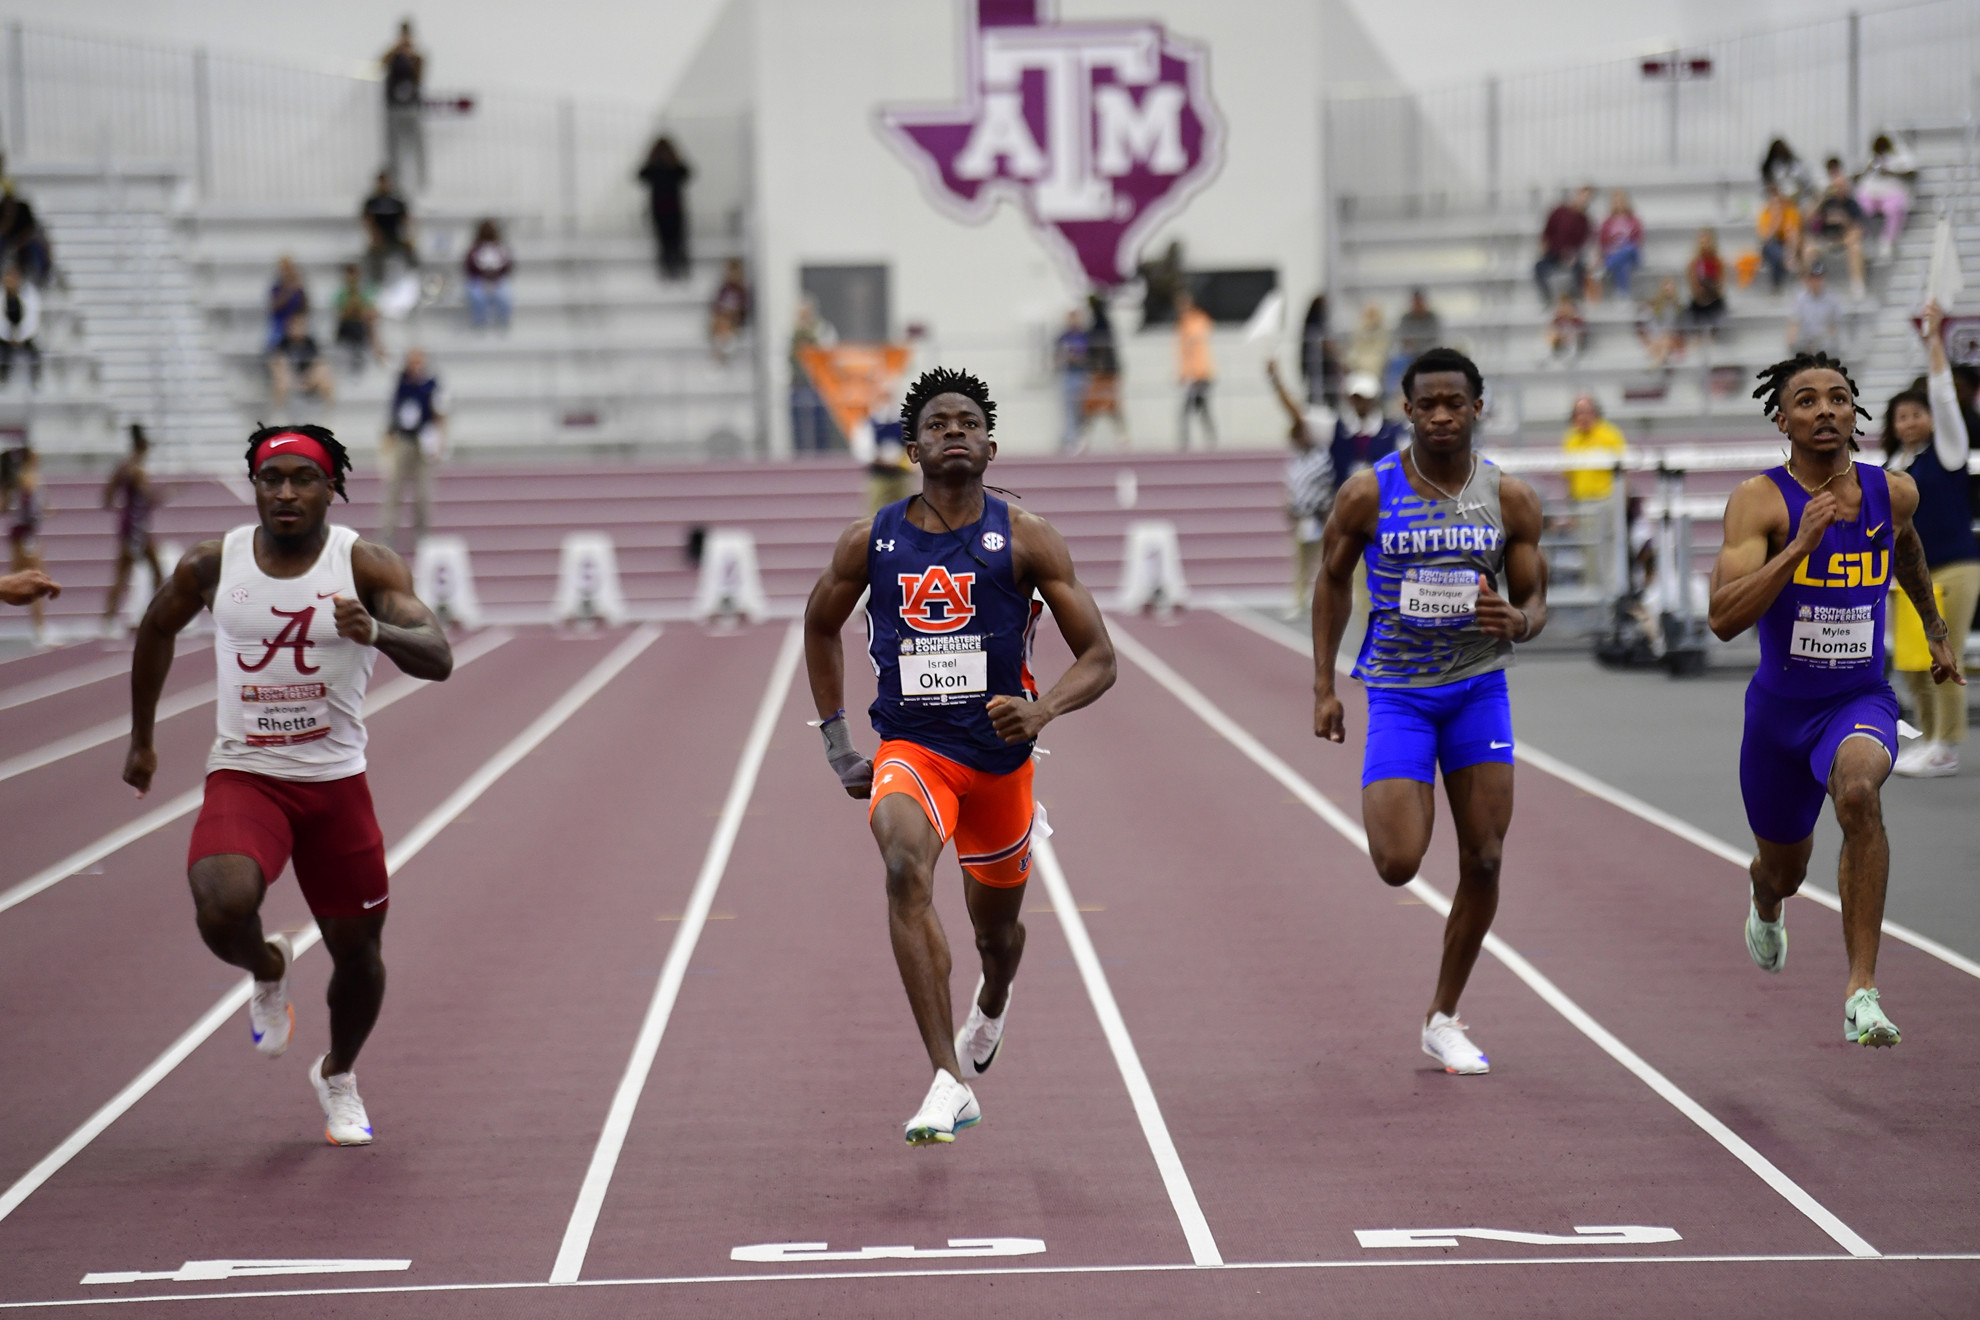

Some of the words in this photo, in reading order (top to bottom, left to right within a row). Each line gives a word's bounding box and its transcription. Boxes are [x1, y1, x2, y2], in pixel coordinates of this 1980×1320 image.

[983, 531, 1005, 551] SEC
[1381, 526, 1500, 555] KENTUCKY
[1793, 549, 1889, 588] LSU
[1419, 575, 1476, 584] CONFERENCE
[1419, 588, 1463, 599] Shavique
[1409, 598, 1470, 614] Bascus
[1814, 605, 1872, 615] SOUTHEASTERN
[1814, 612, 1871, 621] CONFERENCE
[1822, 627, 1851, 638] Myles
[236, 606, 321, 676] A
[915, 635, 981, 646] SOUTHEASTERN
[1799, 637, 1867, 654] Thomas
[915, 642, 981, 652] CONFERENCE
[928, 658, 957, 669] Israel
[919, 672, 967, 689] Okon
[258, 690, 321, 700] CONFERENCE
[264, 706, 307, 714] Jekovan
[258, 716, 317, 732] Rhetta
